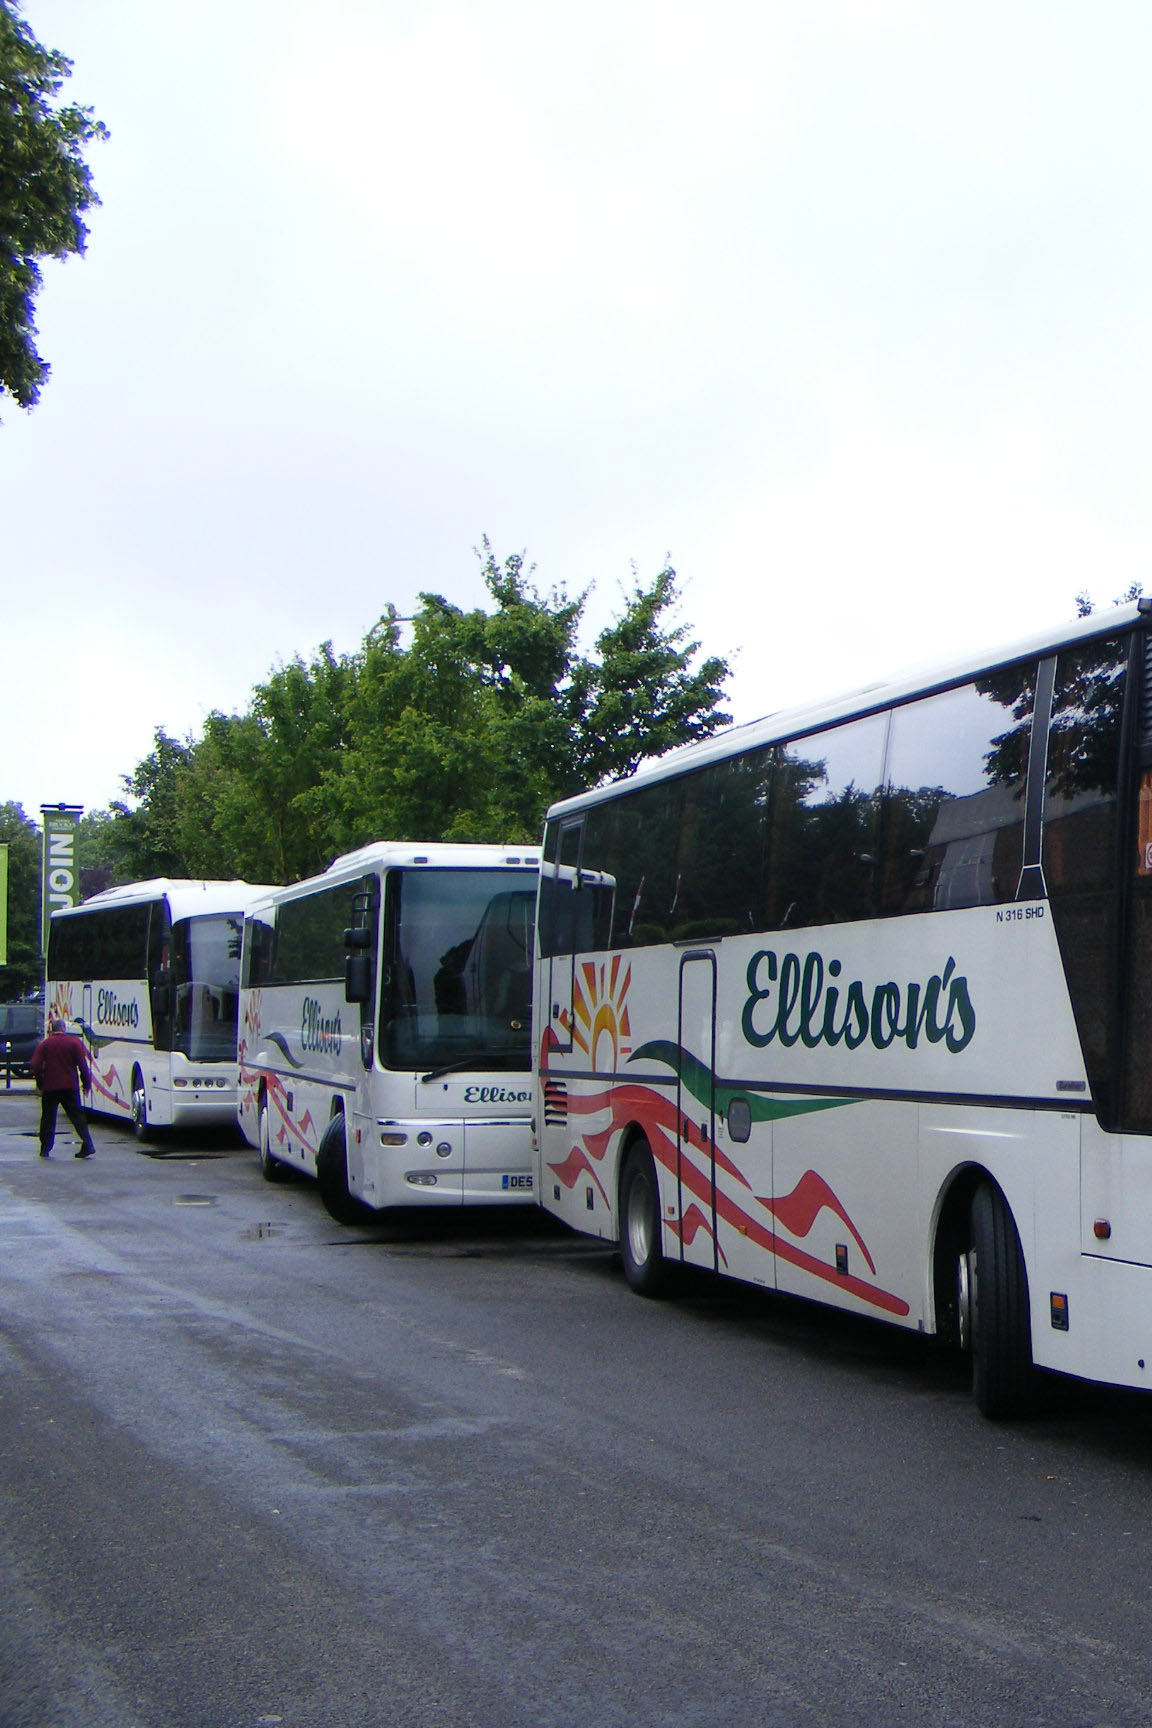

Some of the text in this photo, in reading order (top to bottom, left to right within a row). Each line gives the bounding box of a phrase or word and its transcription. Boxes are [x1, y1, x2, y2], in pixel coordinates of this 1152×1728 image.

[49, 833, 74, 909] JOIN
[996, 906, 1044, 922] N 316 SHD
[97, 988, 139, 1029] Ellison's
[301, 996, 342, 1057] Ellison's
[742, 950, 976, 1054] Ellison's
